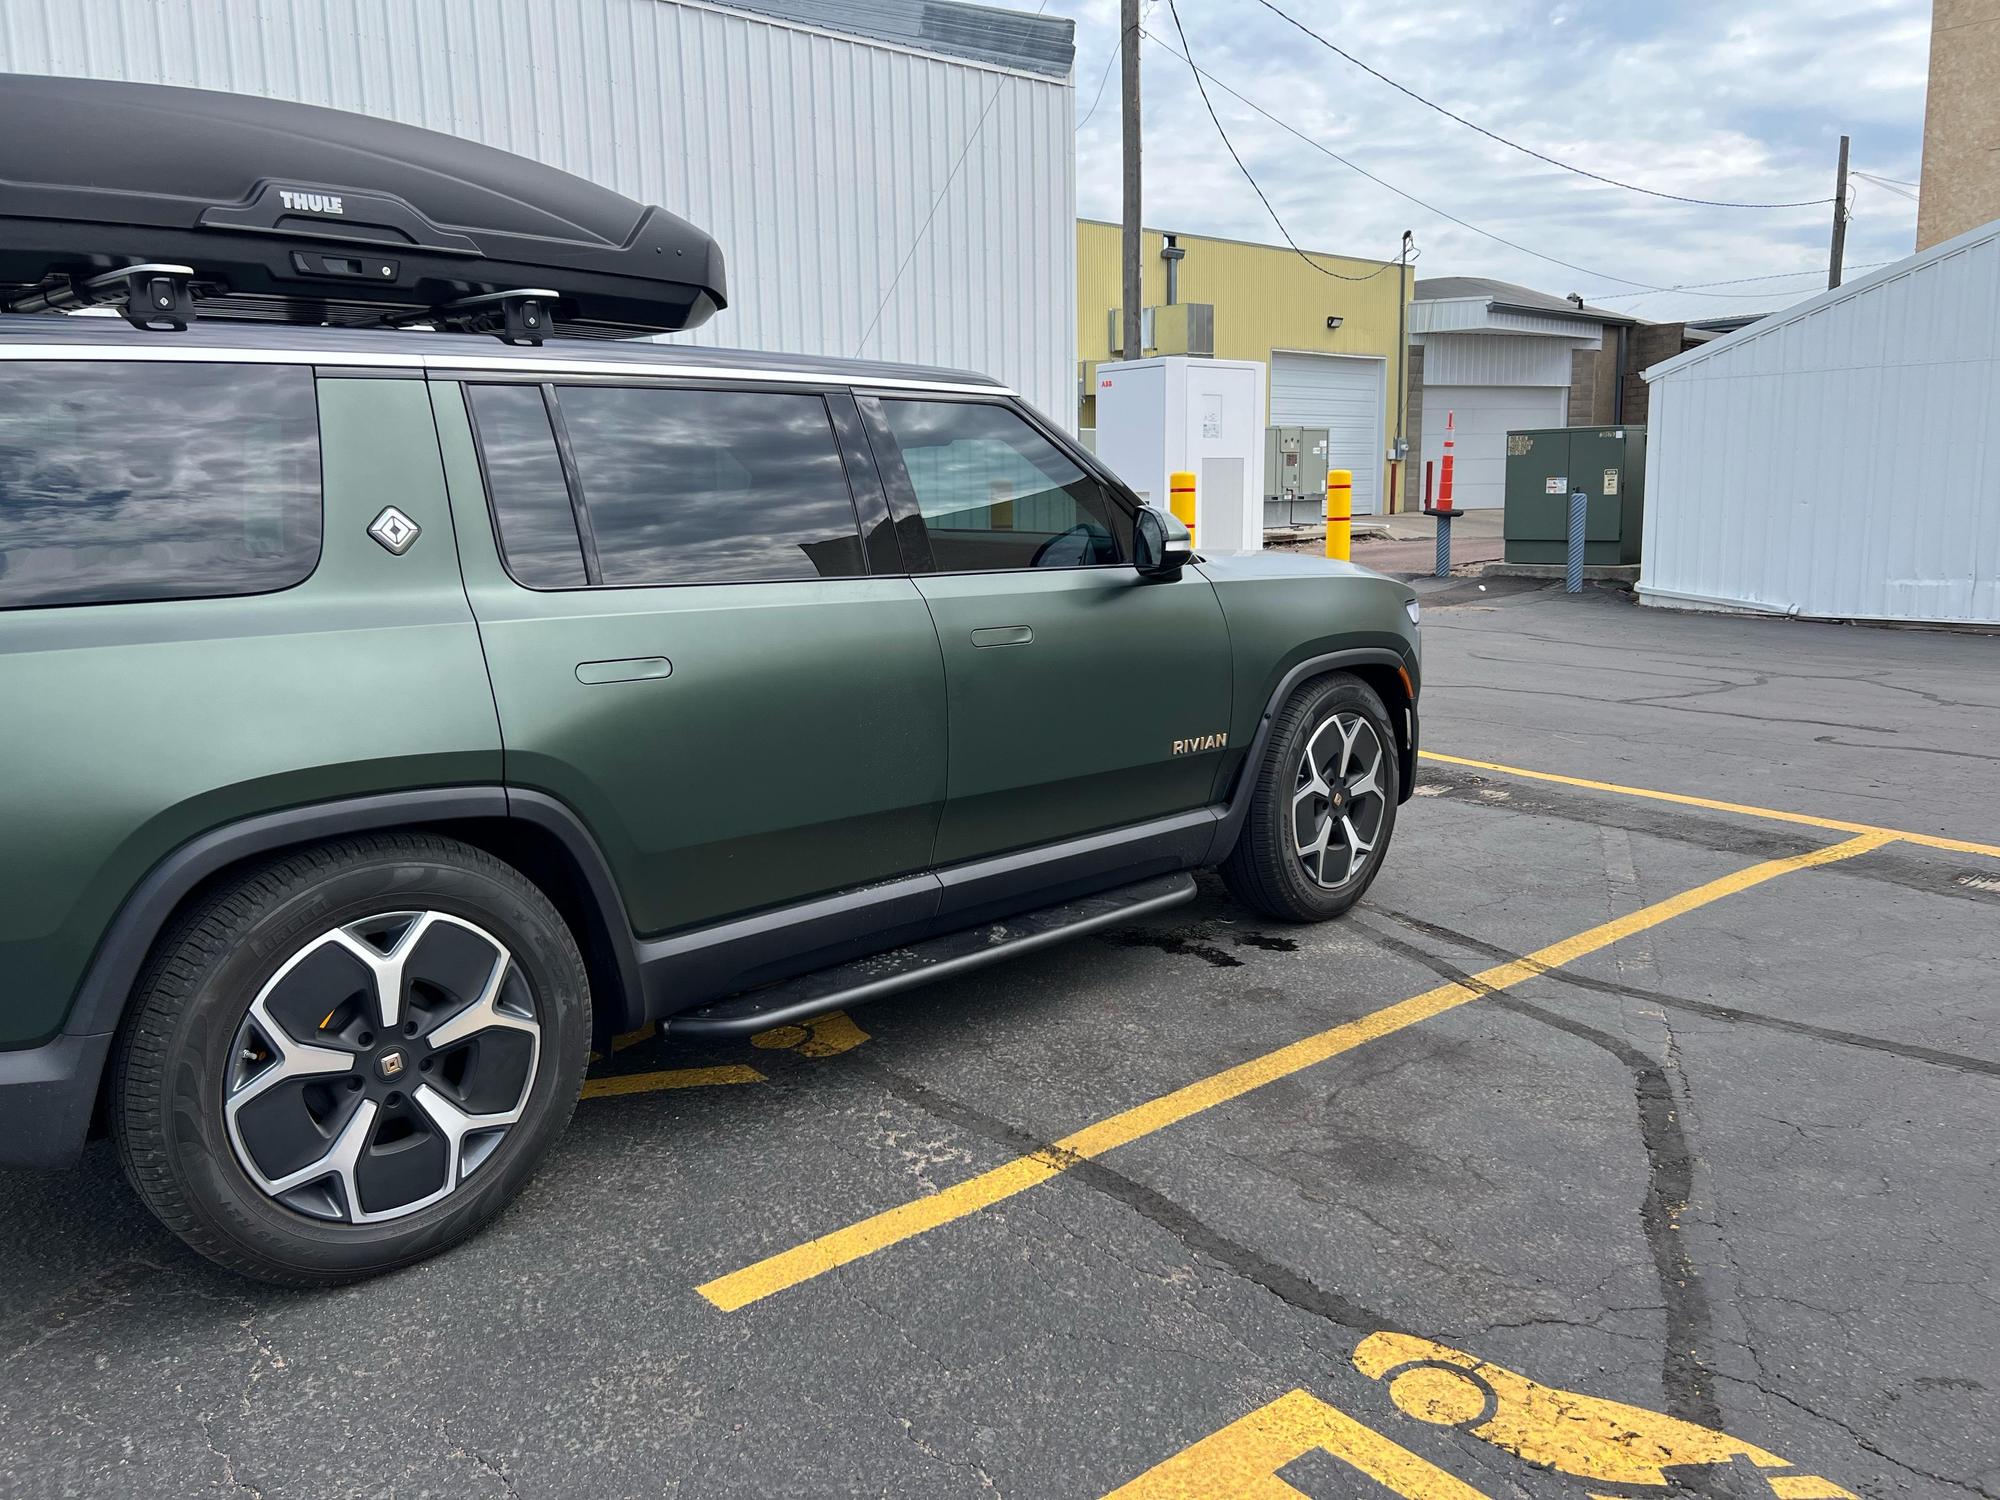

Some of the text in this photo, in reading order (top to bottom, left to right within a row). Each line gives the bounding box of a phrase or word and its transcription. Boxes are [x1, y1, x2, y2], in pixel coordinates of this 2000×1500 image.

[279, 190, 344, 214] THULE
[1101, 380, 1112, 388] ABB
[1172, 732, 1227, 755] RIVIAN
